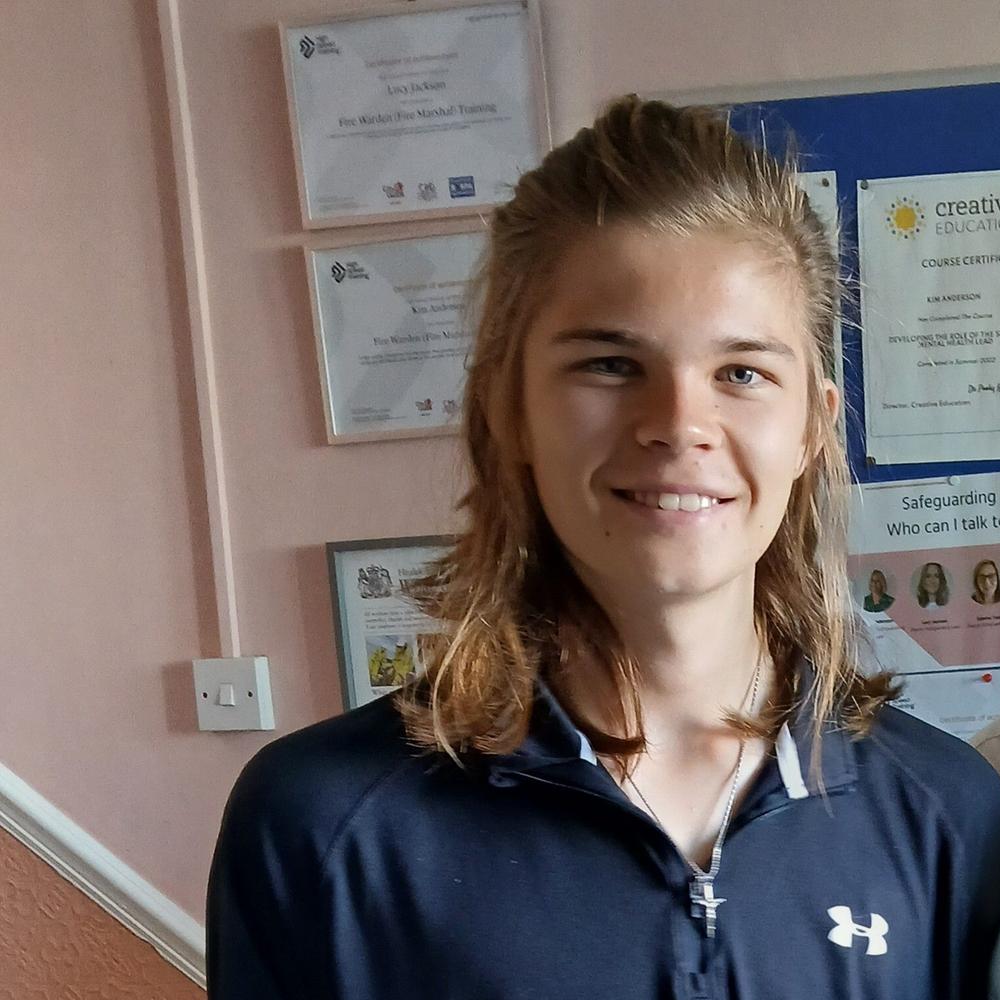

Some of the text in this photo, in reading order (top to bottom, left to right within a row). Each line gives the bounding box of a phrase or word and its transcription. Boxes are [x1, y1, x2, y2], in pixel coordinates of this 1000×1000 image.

[921, 256, 961, 268] COURSE
[927, 293, 981, 303] KIM ANDERSON
[902, 490, 996, 511] Safeguarding
[887, 521, 920, 537] Who
[924, 520, 949, 533] can
[953, 518, 958, 531] I
[962, 515, 988, 531] talk
